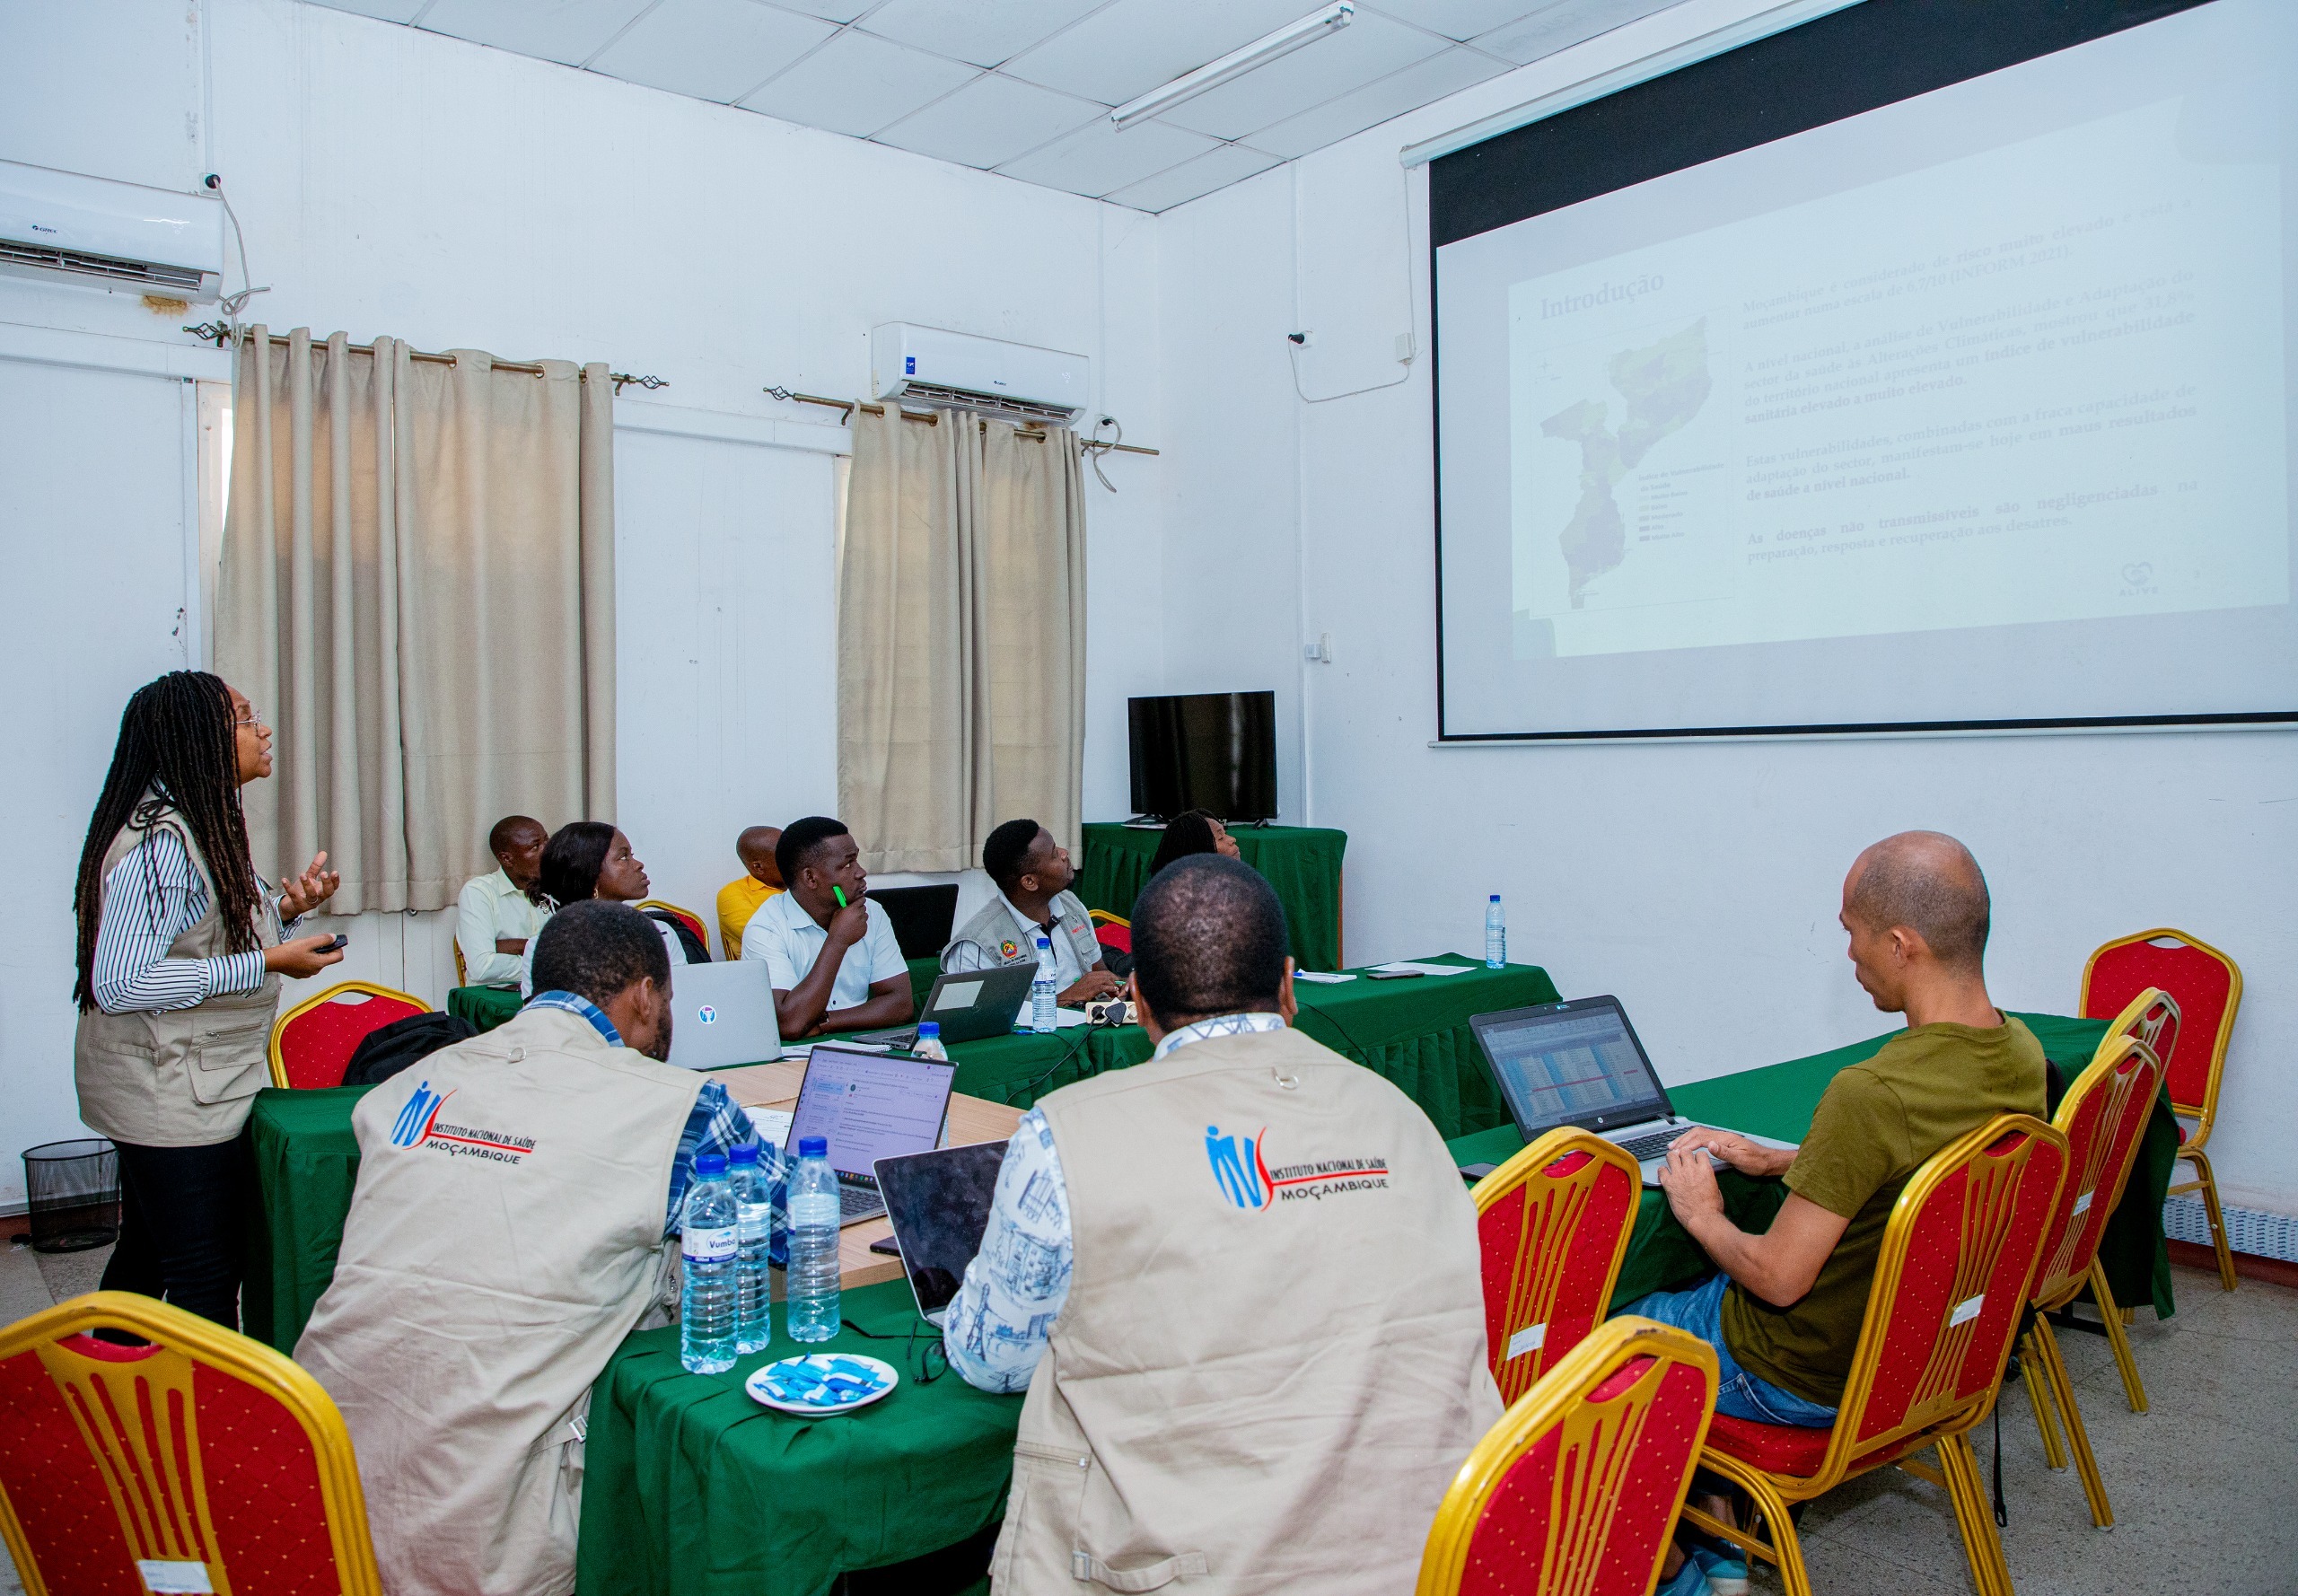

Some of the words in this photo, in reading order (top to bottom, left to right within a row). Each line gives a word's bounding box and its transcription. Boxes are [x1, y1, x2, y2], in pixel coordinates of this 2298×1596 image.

[1843, 260, 1926, 290] considerado
[1933, 254, 1951, 268] de
[1956, 245, 1992, 263] risco
[1998, 232, 2044, 254] muito
[2052, 215, 2115, 241] elevado
[2122, 212, 2132, 223] e
[1540, 273, 1665, 320] Introdução
[1742, 308, 1801, 330] aumentar
[1803, 298, 1841, 317] numa
[1843, 288, 1882, 307] escala
[1887, 284, 1904, 298] de
[1743, 361, 1754, 373] A
[1792, 341, 1850, 364] nacional,
[1853, 340, 1861, 351] a
[1864, 329, 1912, 349] análise
[1916, 324, 1933, 338] de
[1937, 296, 2061, 333] Vulnerabilidade
[2066, 295, 2074, 307] e
[2078, 276, 2167, 304] Adaptação
[2171, 268, 2194, 285] do
[1744, 373, 1780, 390] sector
[1785, 369, 1800, 382] da
[1804, 359, 1842, 379] saúde
[1867, 342, 1939, 366] Alterações
[2033, 312, 2098, 333] mostrou
[2105, 303, 2137, 320] que
[1744, 396, 1760, 408] do
[1764, 383, 1820, 402] território
[1824, 372, 1879, 392] nacional
[1884, 360, 1951, 383] apresenta
[1956, 354, 1979, 367] um
[2037, 338, 2055, 352] de
[2060, 311, 2196, 347] vulnerabilidade
[1744, 405, 1797, 425] sanitária
[1801, 396, 1850, 414] elevado
[1854, 395, 1861, 404] a
[1864, 386, 1905, 403] muito
[1908, 374, 1968, 395] elevado.
[1746, 454, 1776, 468] Estas
[1780, 435, 1894, 462] vulnerabilidades,
[1897, 419, 1982, 443] combinadas
[1987, 415, 2018, 429] com
[2022, 412, 2030, 423] a
[2035, 404, 2073, 421] fraca
[2077, 389, 2171, 416] capacidade
[2175, 382, 2197, 399] de
[1746, 464, 1806, 485] adaptação
[1812, 461, 1829, 474] do
[1833, 455, 1875, 471] sector,
[1881, 439, 1984, 464] manifestam-se
[1989, 432, 2023, 448] hoje
[2029, 429, 2052, 441] em
[2059, 421, 2102, 436] maus
[2109, 405, 2197, 430] resultados
[1746, 489, 1762, 502] de
[1764, 481, 1801, 499] saúde
[1802, 484, 1811, 493] a
[1813, 476, 1846, 492] nível
[1850, 467, 1910, 487] nacional.
[1747, 531, 1764, 545] As
[1776, 524, 1827, 541] doenças
[1840, 521, 1864, 534] não
[1879, 505, 1979, 530] transmissíveis
[1995, 501, 2021, 514] são
[2037, 483, 2158, 511] negligenciadas
[2177, 480, 2198, 493] na
[1748, 544, 1819, 566] preparação,
[1821, 538, 1875, 555] resposta
[1879, 537, 1886, 547] e
[1890, 525, 1973, 548] recuperação
[1977, 523, 2002, 536] aos
[426, 1140, 522, 1165] MOÇAMBIQUE
[433, 1123, 468, 1136] INSTITUTO
[469, 1129, 502, 1143] NACIONAL
[502, 1135, 513, 1144] DE
[514, 1136, 537, 1150] SAÚDE
[1270, 1164, 1314, 1180] INSTITUTO
[1316, 1160, 1355, 1174] NACIONAL
[1356, 1159, 1365, 1170] DE
[1365, 1156, 1387, 1170] SAÚDE
[1281, 1179, 1389, 1200] MOÇAMBIQUE
[709, 1239, 736, 1248] Vumba
